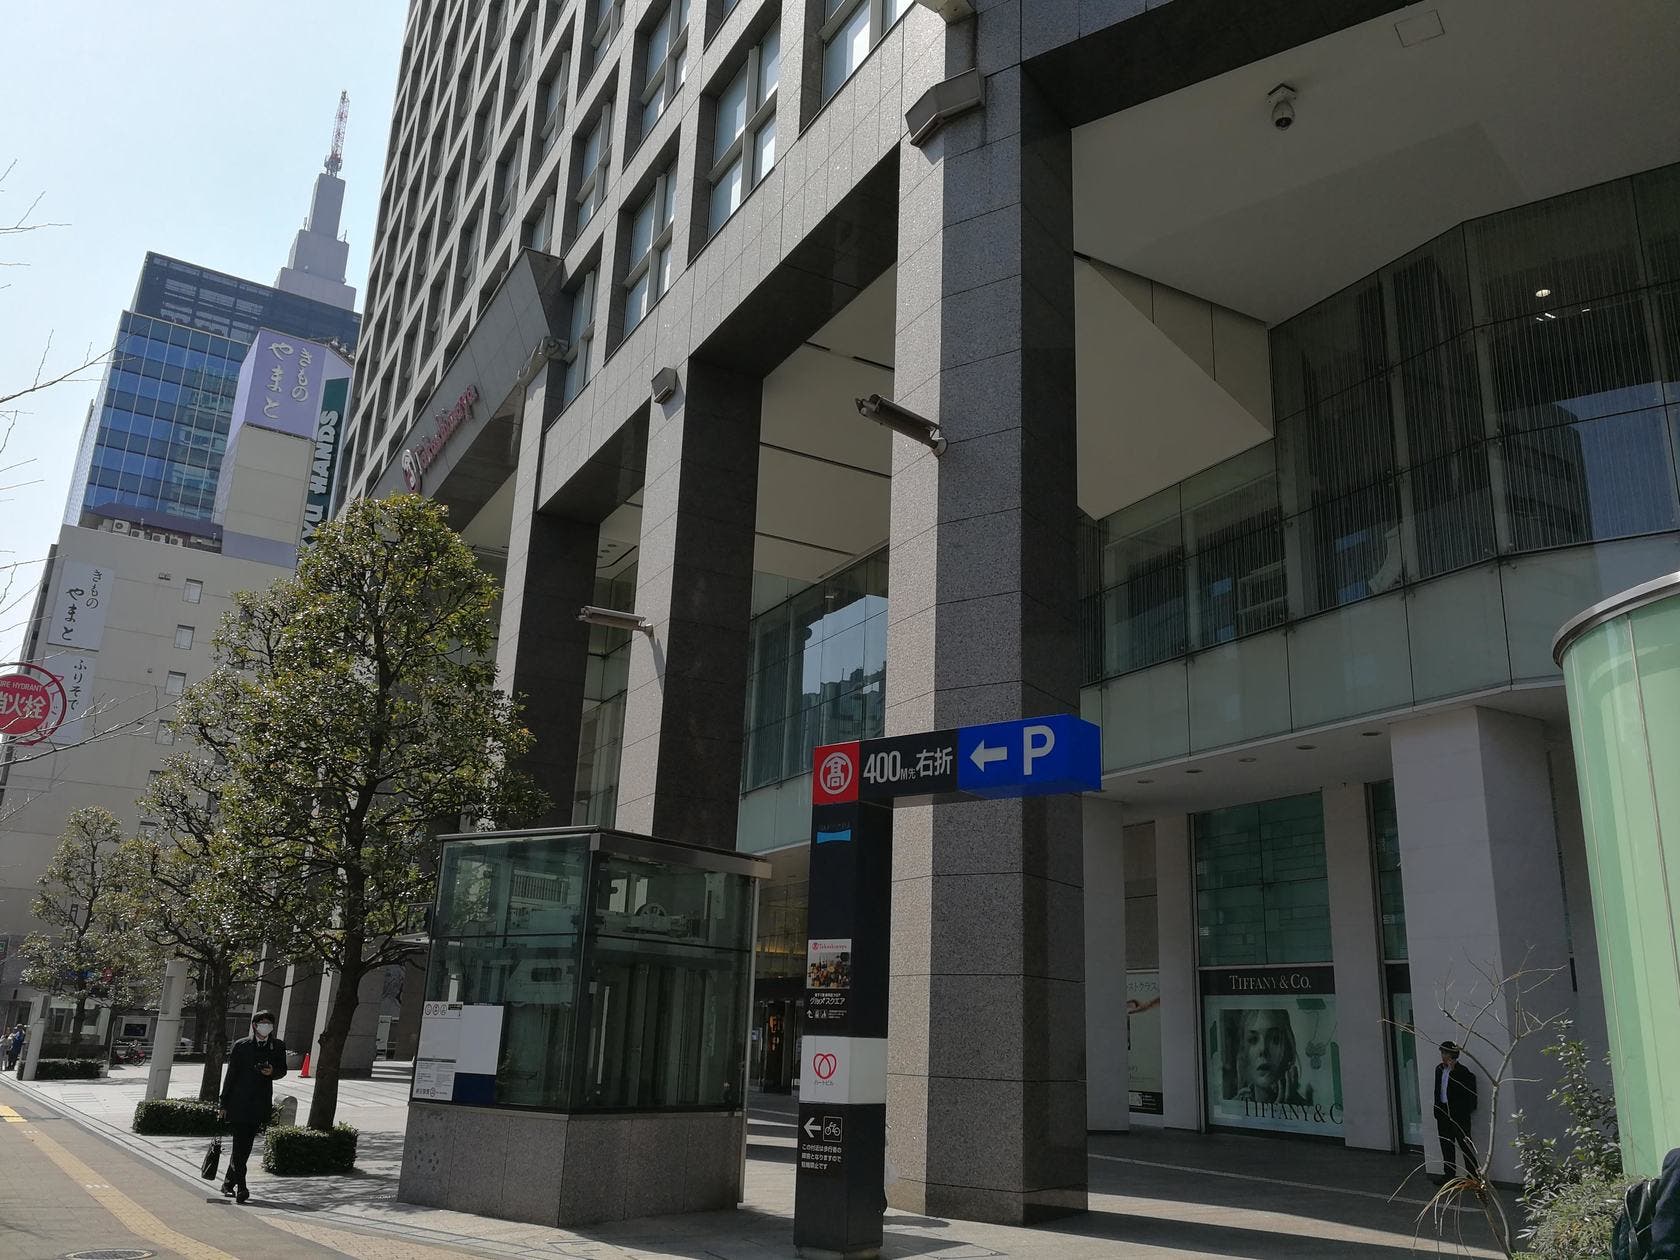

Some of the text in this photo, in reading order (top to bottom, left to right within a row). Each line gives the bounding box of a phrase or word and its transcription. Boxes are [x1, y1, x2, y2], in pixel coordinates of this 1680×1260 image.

[308, 410, 339, 494] HANDS
[61, 587, 85, 640] やまと
[86, 569, 102, 610] きもの
[67, 659, 87, 711] ふりそで
[1023, 725, 1056, 777] P
[1229, 975, 1277, 990] TIFFANY
[1279, 975, 1289, 989] &
[1244, 1097, 1310, 1121] TIFFANY
[1313, 1103, 1327, 1123] &
